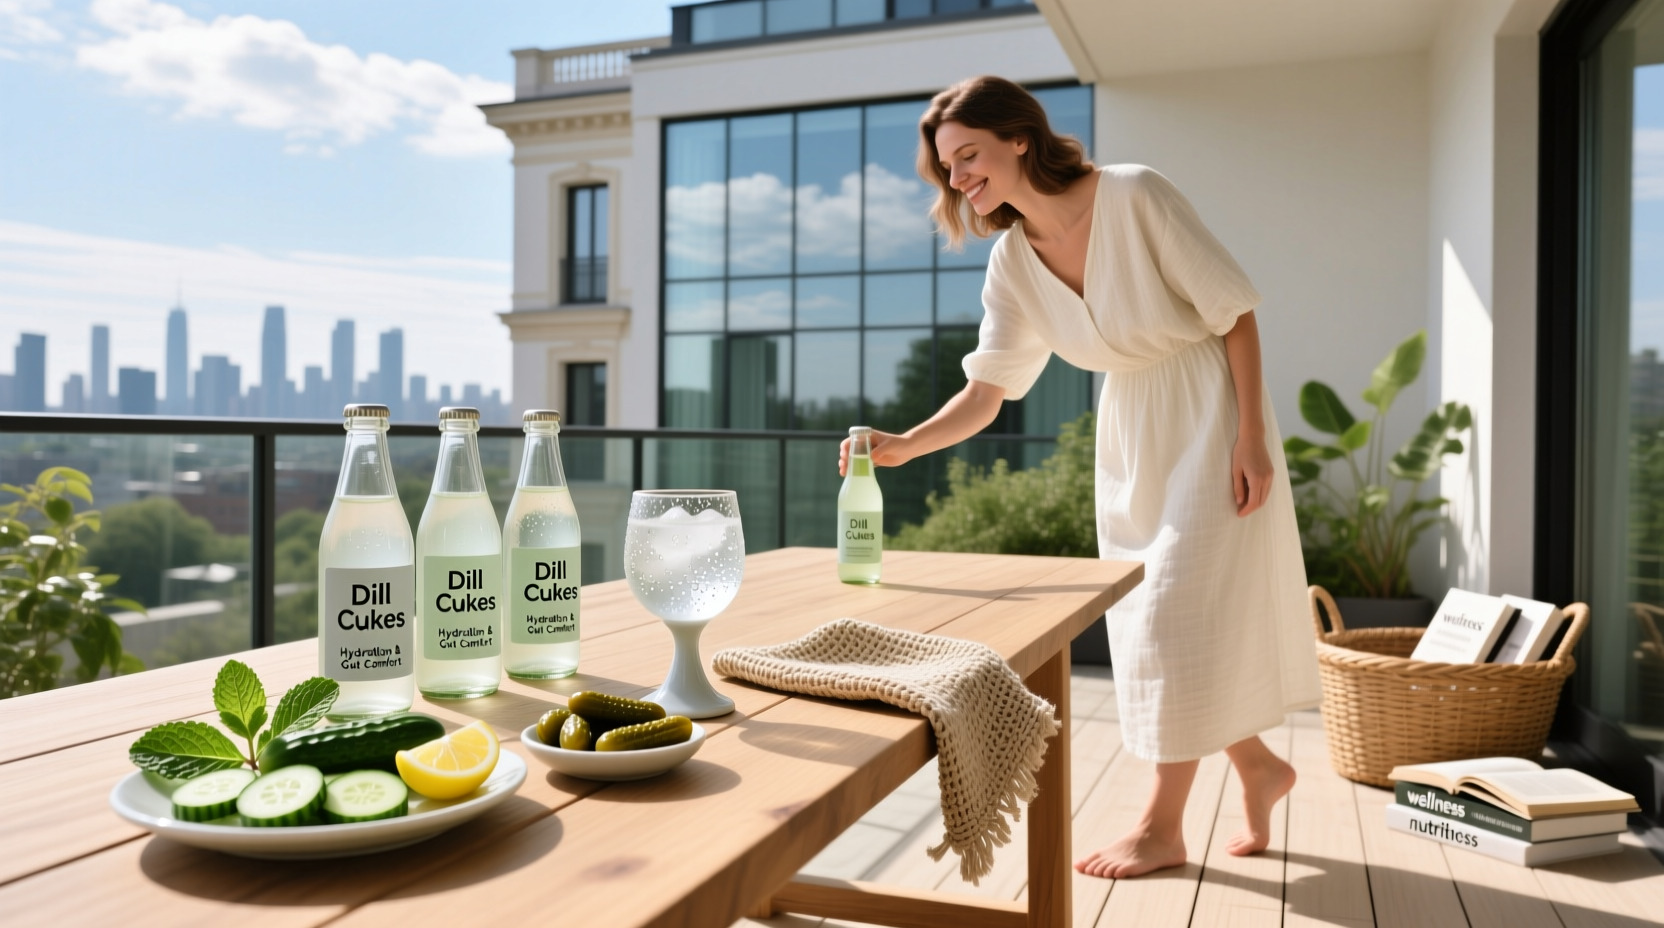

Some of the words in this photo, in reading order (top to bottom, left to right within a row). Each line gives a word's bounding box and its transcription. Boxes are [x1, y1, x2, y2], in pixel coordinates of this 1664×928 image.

[850, 518, 868, 529] Dill
[448, 569, 483, 590] Dill
[535, 560, 567, 581] Dill
[351, 582, 391, 606] Dill
[436, 593, 496, 613] Cukes
[523, 583, 578, 602] Cukes
[337, 609, 406, 631] Cukes
[1407, 790, 1466, 818] wellness
